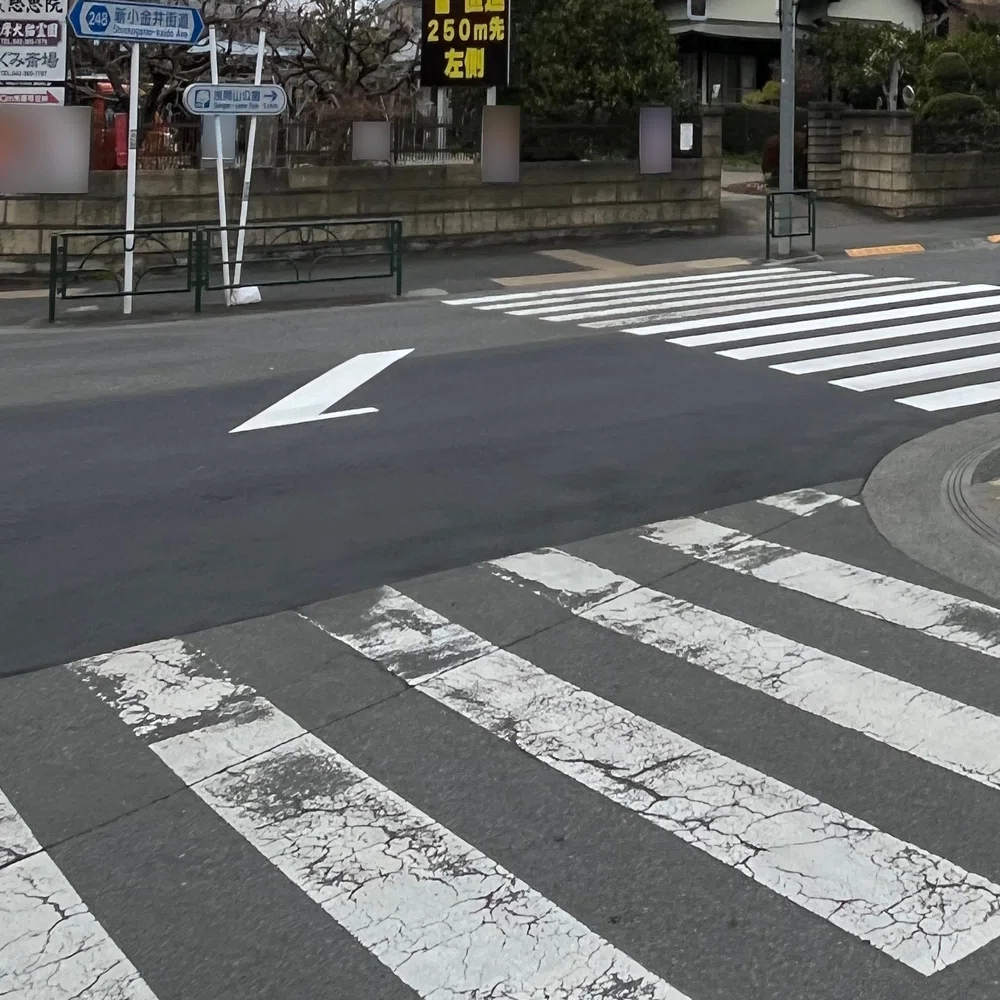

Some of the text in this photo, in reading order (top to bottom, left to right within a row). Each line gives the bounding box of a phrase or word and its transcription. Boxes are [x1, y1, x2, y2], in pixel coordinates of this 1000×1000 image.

[88, 11, 108, 27] 248
[114, 7, 189, 29] 新小金井街道
[427, 16, 505, 42] 250m先
[444, 48, 485, 79] 左側
